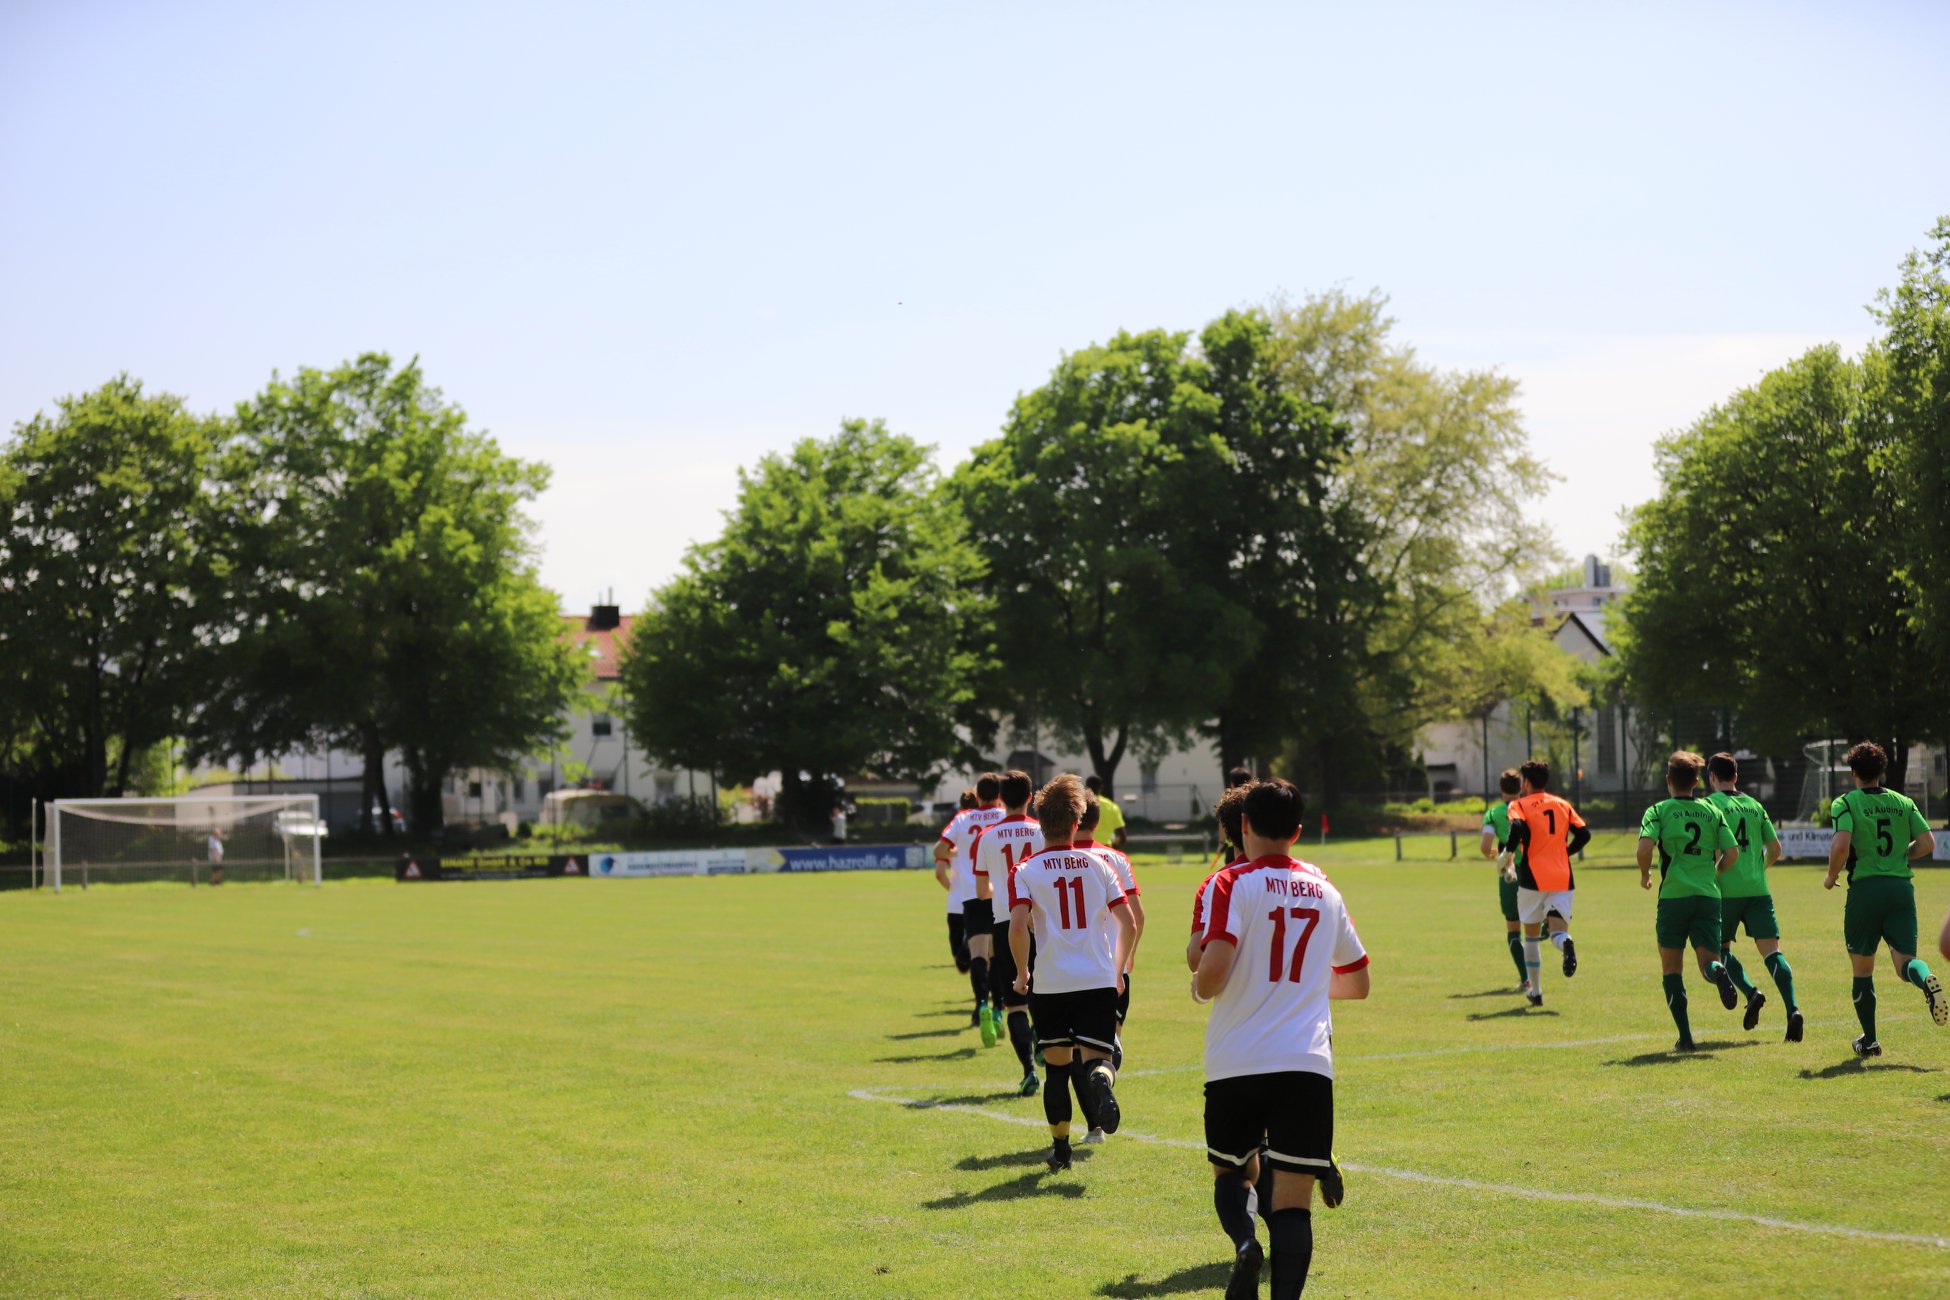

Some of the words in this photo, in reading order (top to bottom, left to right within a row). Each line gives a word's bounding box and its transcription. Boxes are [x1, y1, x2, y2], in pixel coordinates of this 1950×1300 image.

[970, 813, 982, 821] MTV
[983, 812, 999, 820] BERG
[1543, 809, 1555, 835] 1
[1673, 811, 1683, 820] SV
[1684, 810, 1713, 822] Aubing
[1724, 807, 1734, 815] SV
[1864, 808, 1874, 817] SV
[1875, 806, 1904, 817] Aubing
[997, 829, 1013, 839] MTV
[1015, 828, 1035, 837] BERG
[1683, 822, 1702, 856] 2
[1733, 817, 1749, 853] 4
[1876, 819, 1893, 857] 5
[1043, 859, 1062, 870] MTV
[1065, 857, 1089, 870] BERG
[1265, 876, 1288, 896] MTV
[1291, 881, 1323, 899] BERG
[1053, 877, 1087, 930] 11
[1268, 906, 1320, 983] 17
